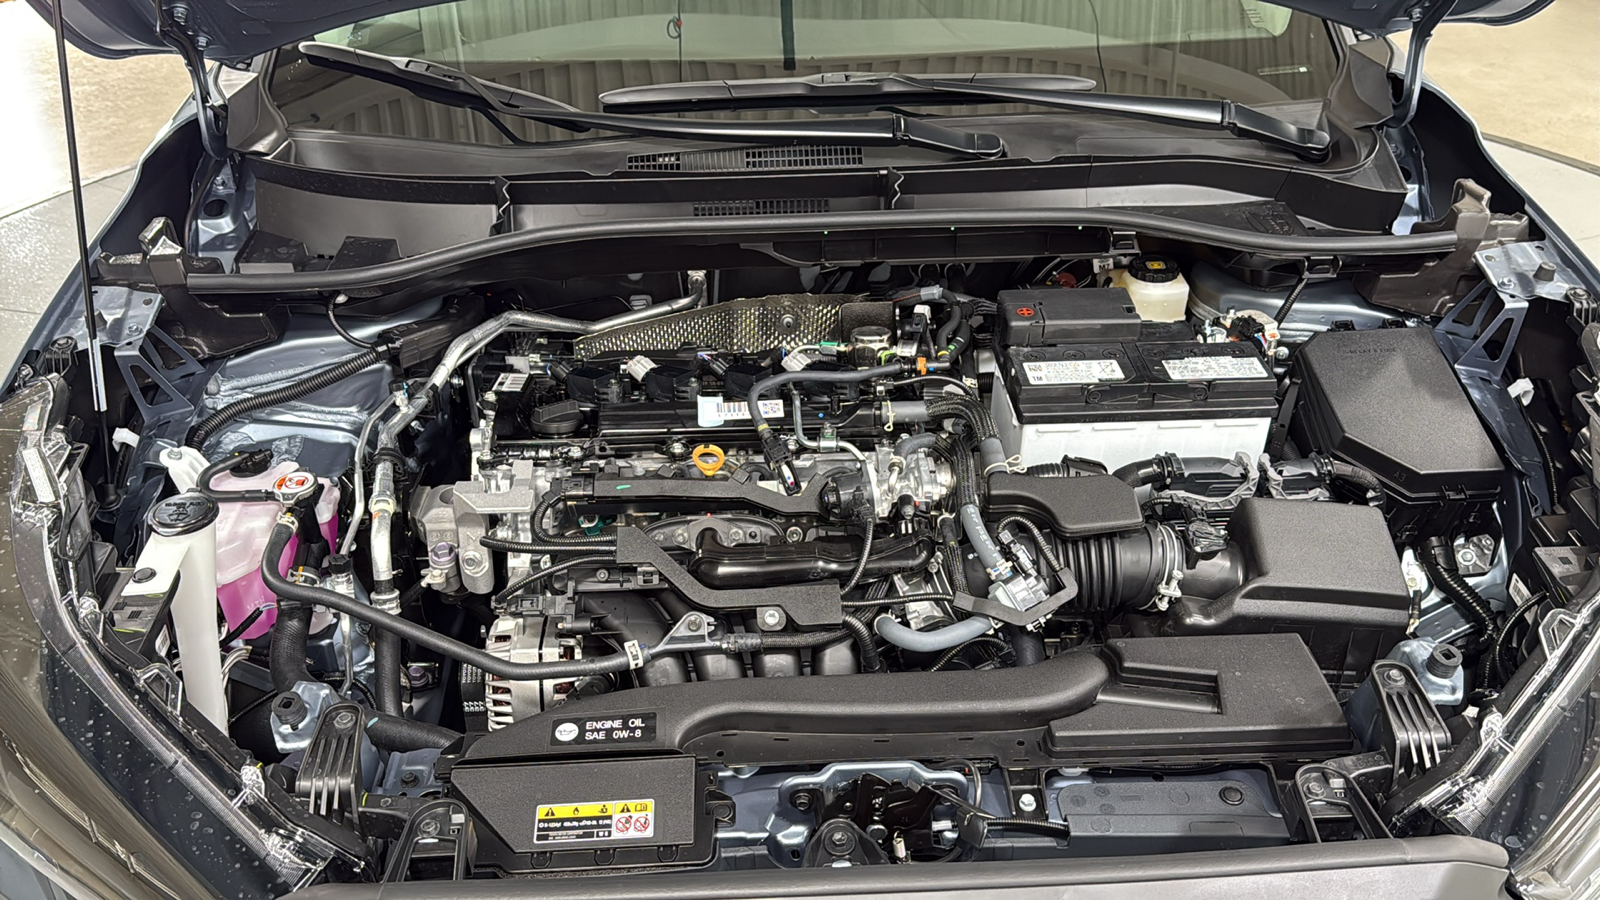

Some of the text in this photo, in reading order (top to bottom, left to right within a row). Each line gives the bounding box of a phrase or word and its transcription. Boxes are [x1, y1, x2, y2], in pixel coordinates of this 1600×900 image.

[586, 718, 645, 730] ENGINE OIL
[584, 729, 642, 740] SAE 0W-8
